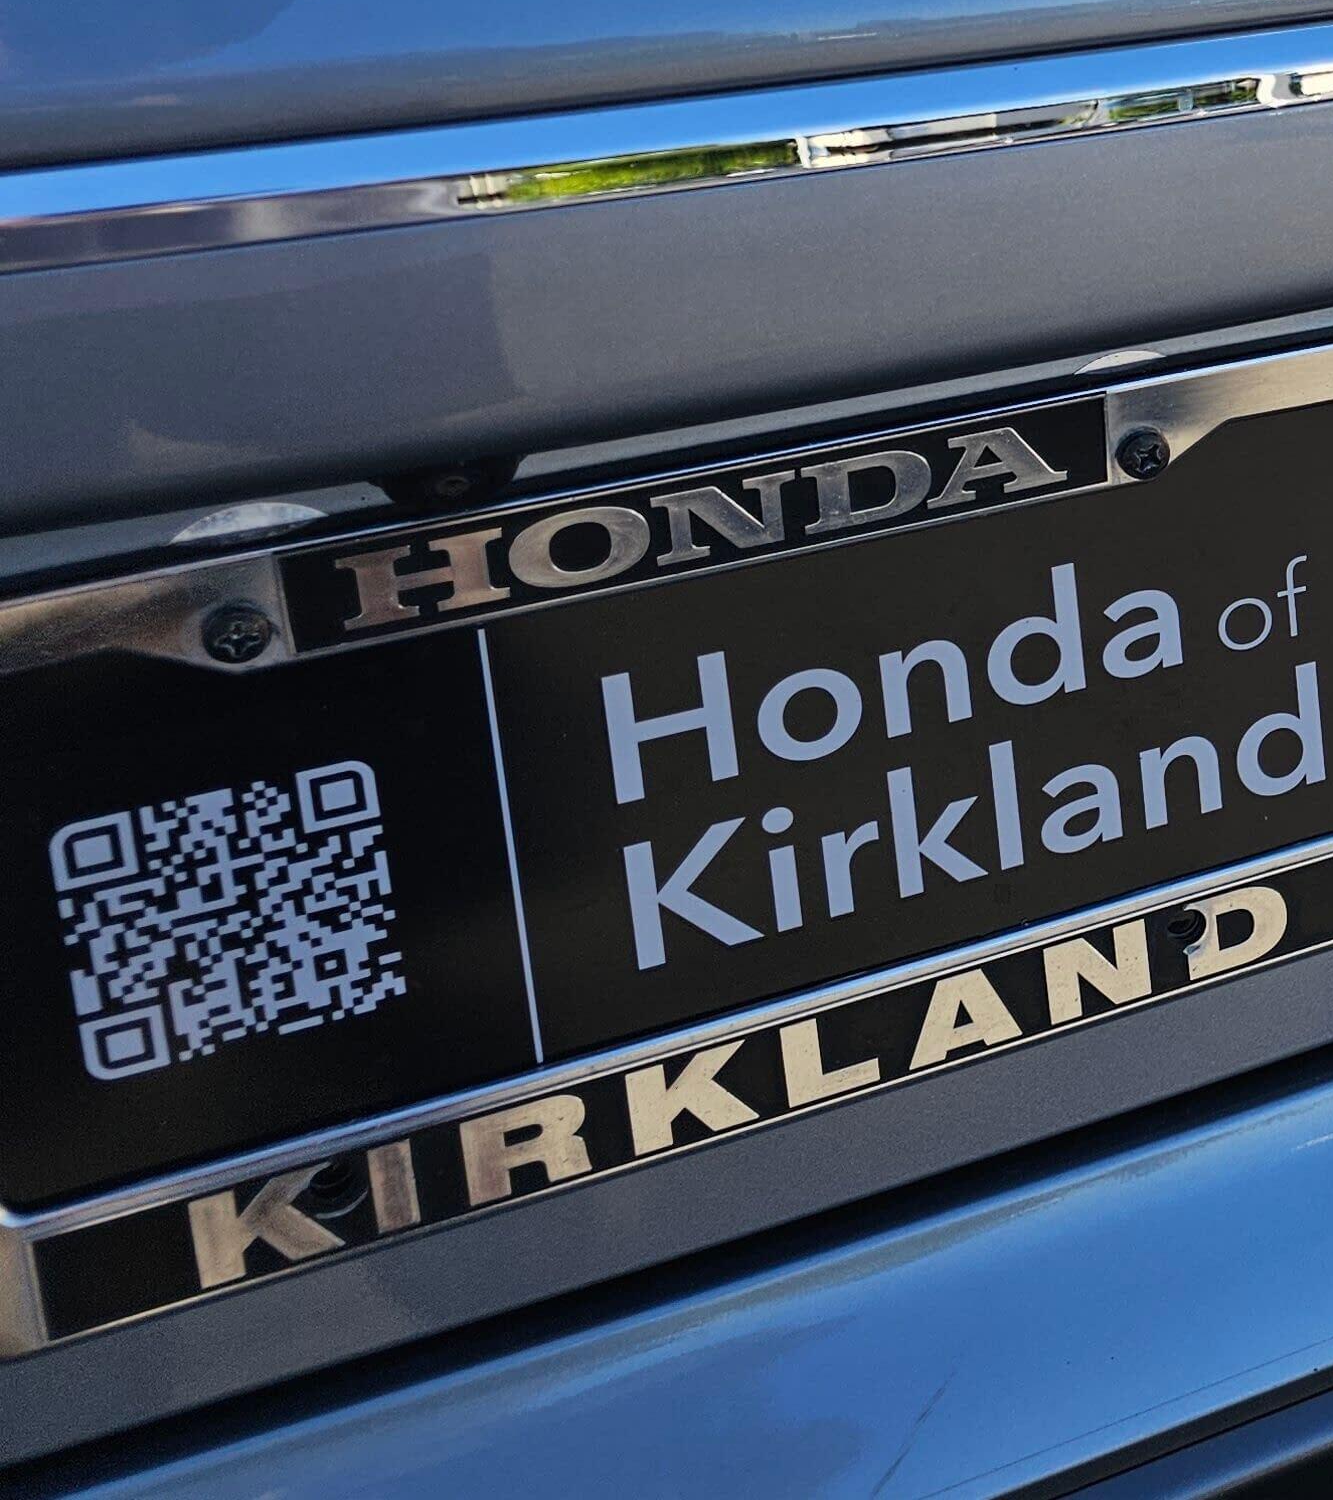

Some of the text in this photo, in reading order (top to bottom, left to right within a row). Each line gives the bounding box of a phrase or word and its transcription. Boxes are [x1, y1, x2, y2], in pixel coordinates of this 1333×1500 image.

[335, 426, 1068, 632] HONDA
[600, 556, 1308, 805] Honda of
[622, 663, 1328, 971] Kirkland
[188, 888, 1288, 1290] KIRKLAND
